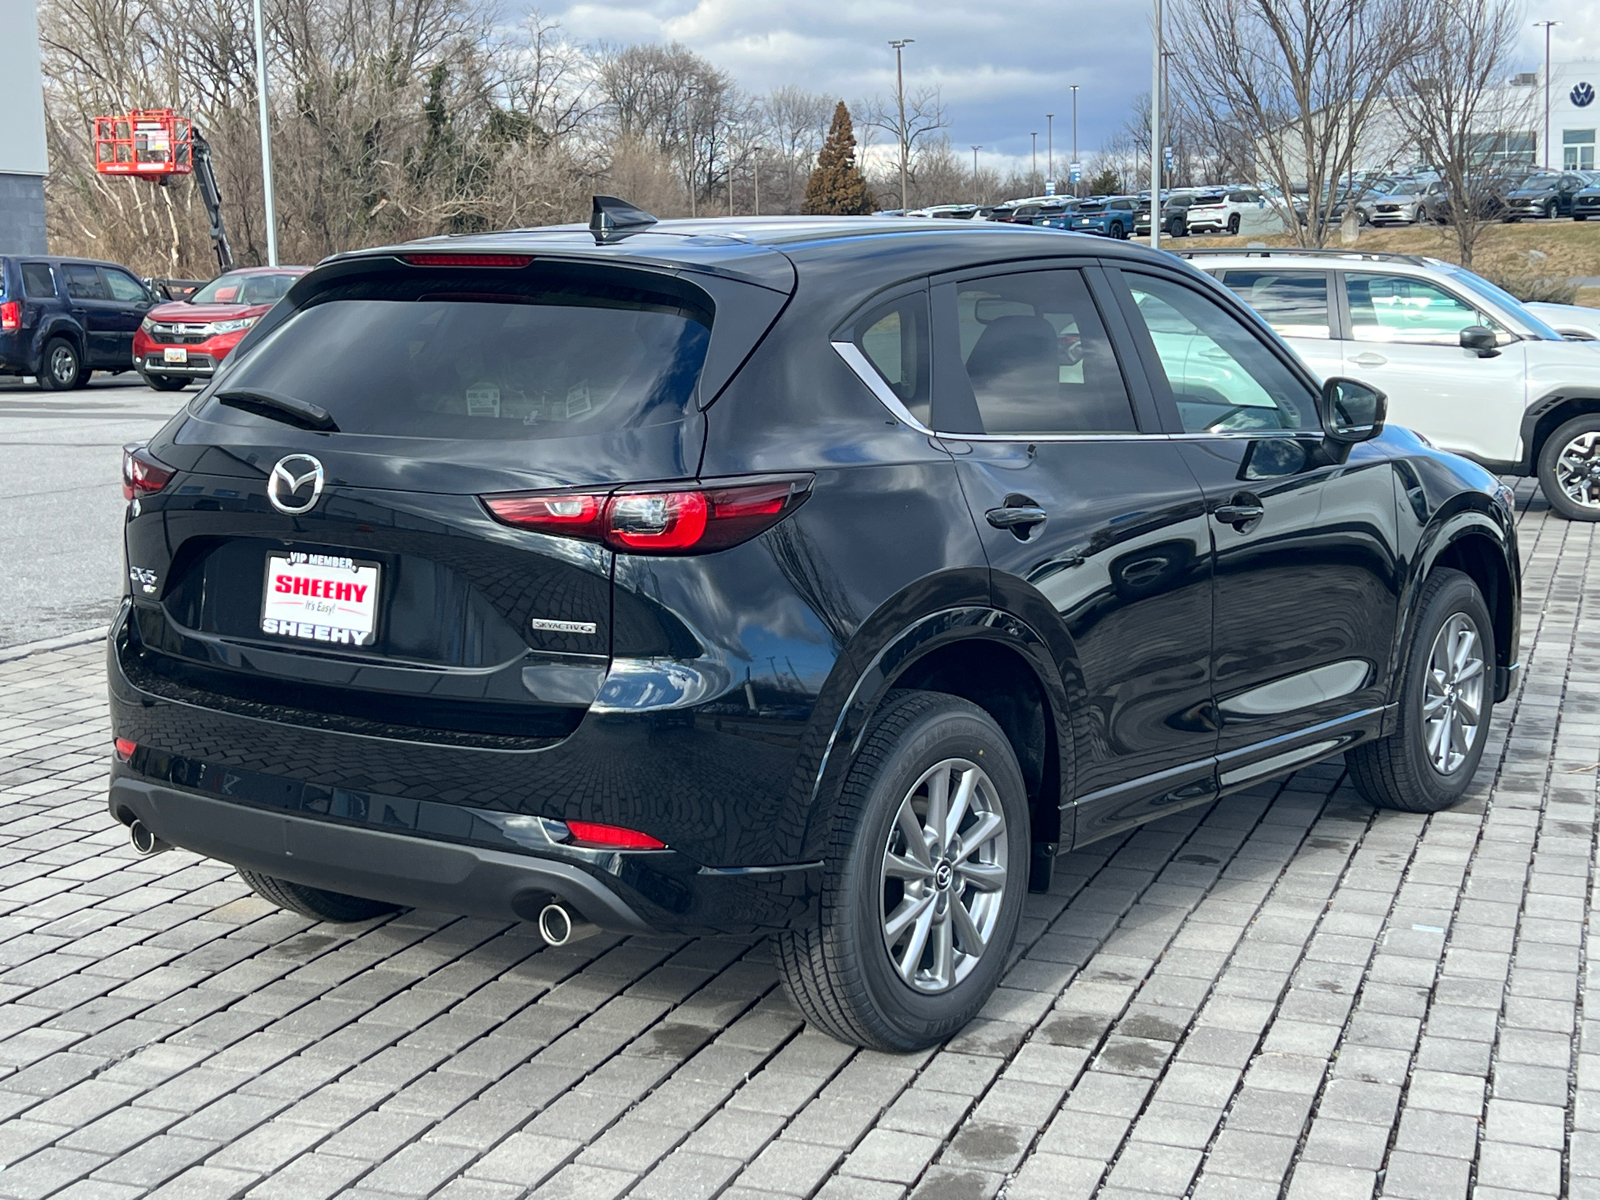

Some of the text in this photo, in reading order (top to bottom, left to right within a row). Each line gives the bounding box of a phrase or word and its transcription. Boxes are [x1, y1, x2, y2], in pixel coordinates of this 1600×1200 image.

[290, 551, 353, 569] VIP MEMBER
[275, 574, 369, 603] SHEEHY
[304, 599, 337, 616] It's Easy!
[262, 618, 370, 646] SHEEHY
